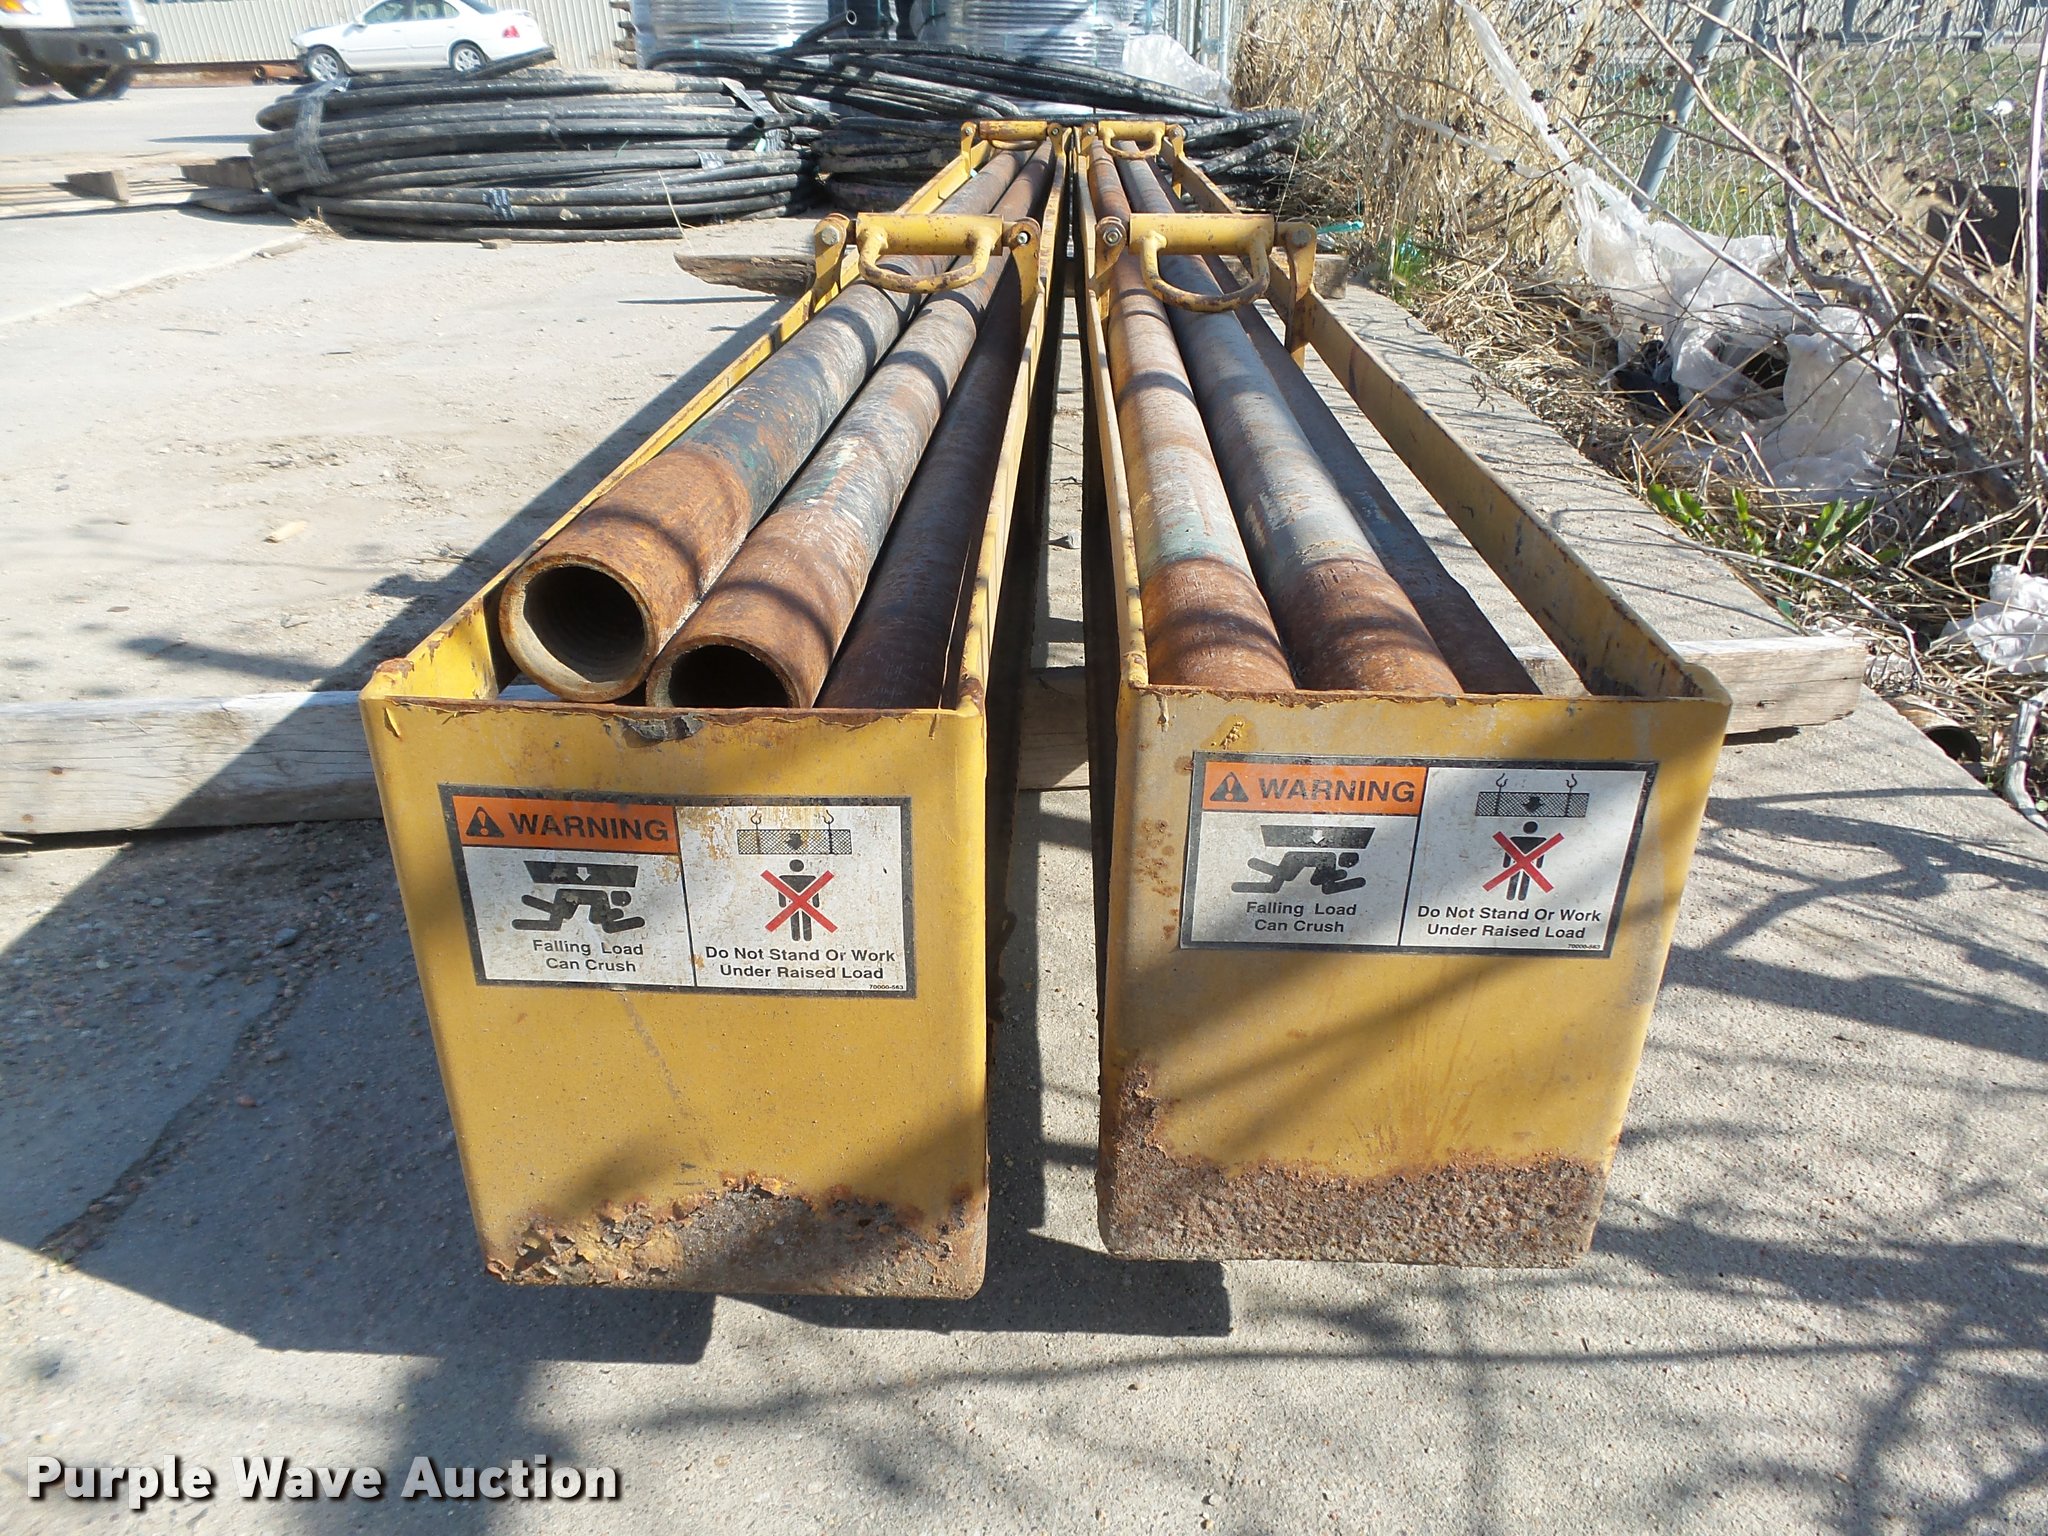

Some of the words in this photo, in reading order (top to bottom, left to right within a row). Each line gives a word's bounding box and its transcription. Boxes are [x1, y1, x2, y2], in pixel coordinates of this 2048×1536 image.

[1259, 775, 1416, 803] WARNING
[508, 811, 668, 842] WARNING
[1246, 900, 1304, 916] Falling
[1315, 902, 1357, 916] Load
[1418, 904, 1439, 919] Do
[1446, 905, 1475, 920] Not
[1480, 906, 1529, 922] Stand
[1534, 907, 1554, 922] Or
[1560, 907, 1601, 923] Work
[1254, 919, 1288, 932] Can
[1293, 919, 1345, 933] Crush
[1426, 923, 1477, 937] Under
[1484, 924, 1539, 939] Raised
[1545, 925, 1585, 939] Load
[533, 939, 591, 956] Falling
[602, 942, 643, 956] Load
[705, 945, 727, 960] Do
[733, 947, 764, 962] Not
[768, 948, 819, 963] Stand
[826, 948, 848, 963] Or
[851, 949, 896, 963] Work
[545, 956, 580, 970] Can
[585, 957, 637, 972] Crush
[719, 964, 771, 979] Under
[777, 966, 836, 980] Raised
[842, 966, 884, 980] Load
